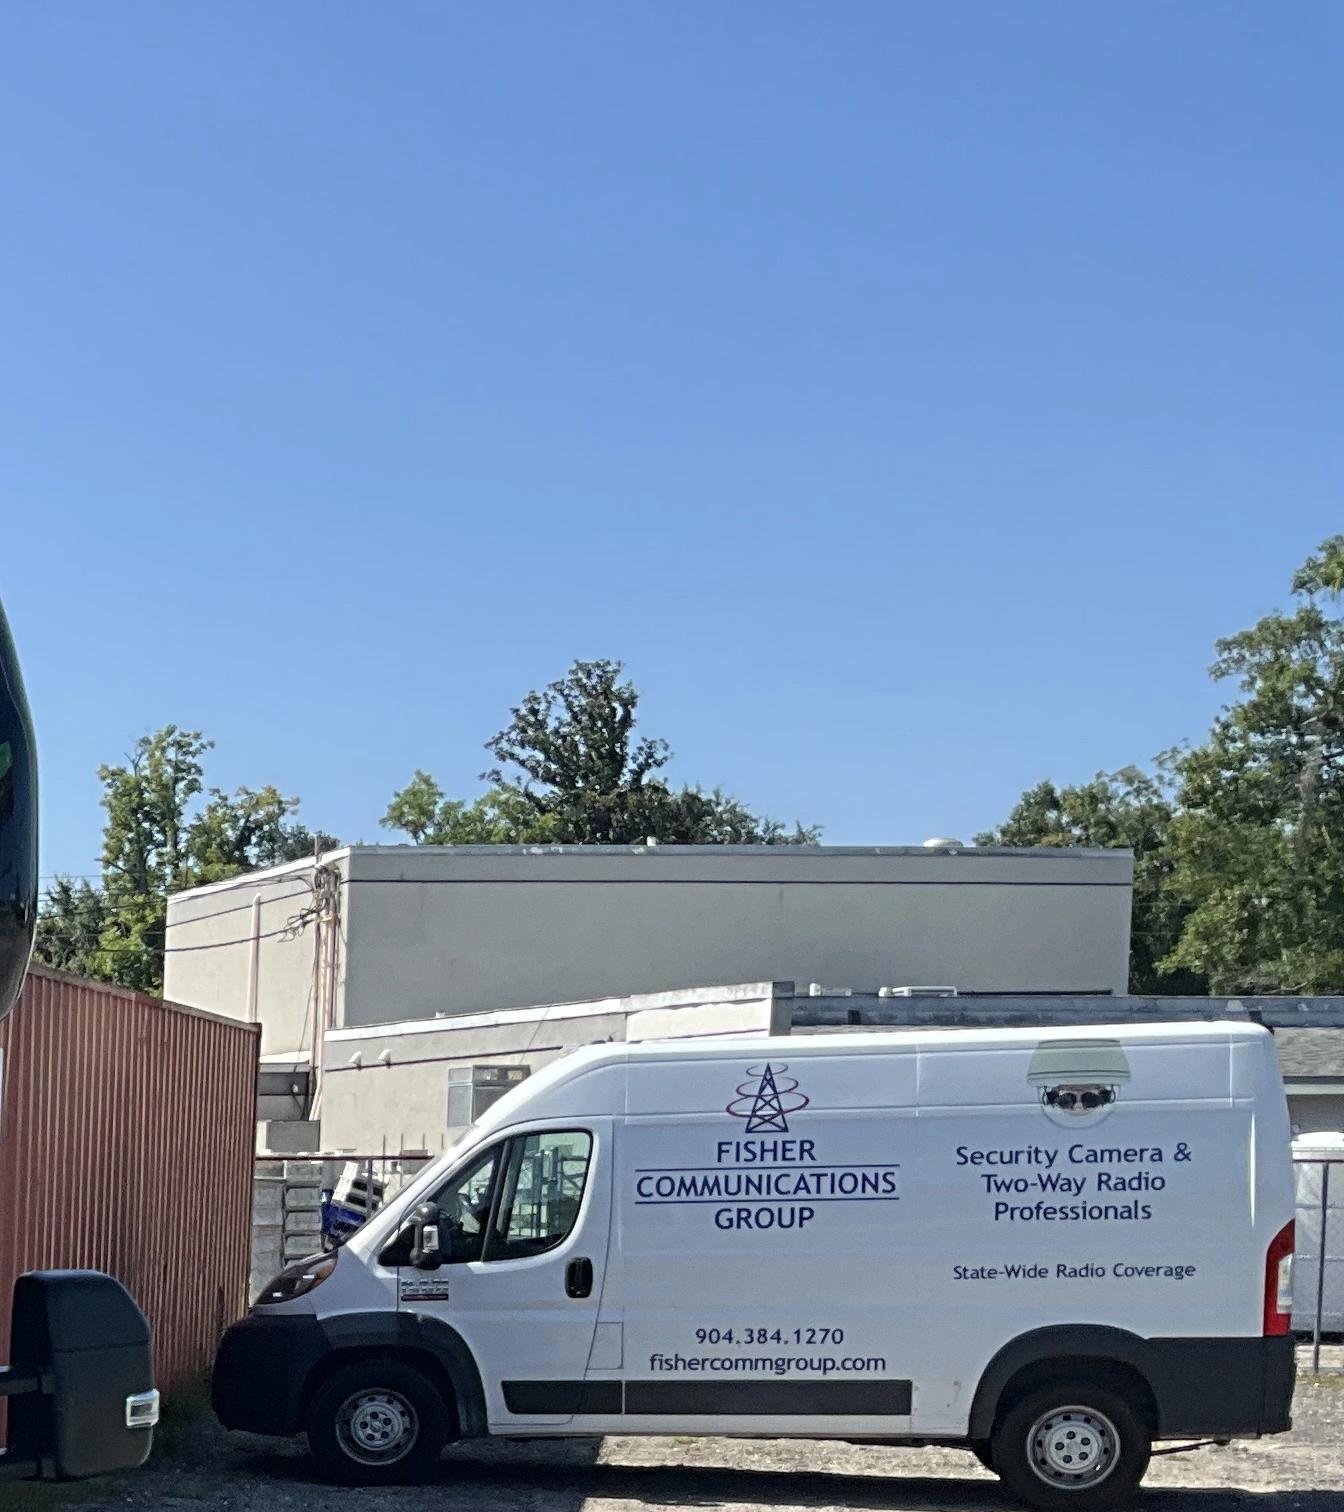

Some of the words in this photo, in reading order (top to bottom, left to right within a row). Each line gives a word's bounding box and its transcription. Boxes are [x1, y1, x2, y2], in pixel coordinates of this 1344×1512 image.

[716, 1139, 817, 1164] FISHER
[955, 1144, 1059, 1170] Security
[1067, 1143, 1164, 1165] Camera
[1173, 1141, 1192, 1163] &
[634, 1171, 897, 1198] COMMUNICATIONS
[980, 1172, 1088, 1198] Two-Way
[1096, 1170, 1166, 1192] Radio
[714, 1206, 815, 1231] GROUP
[994, 1199, 1153, 1222] Professionals
[953, 1263, 1049, 1281] State-Wide
[1056, 1262, 1106, 1279] Radio
[1112, 1262, 1197, 1281] Coverage
[695, 1327, 845, 1345] 904.384.1270
[649, 1352, 887, 1375] fishercommgroup.com
